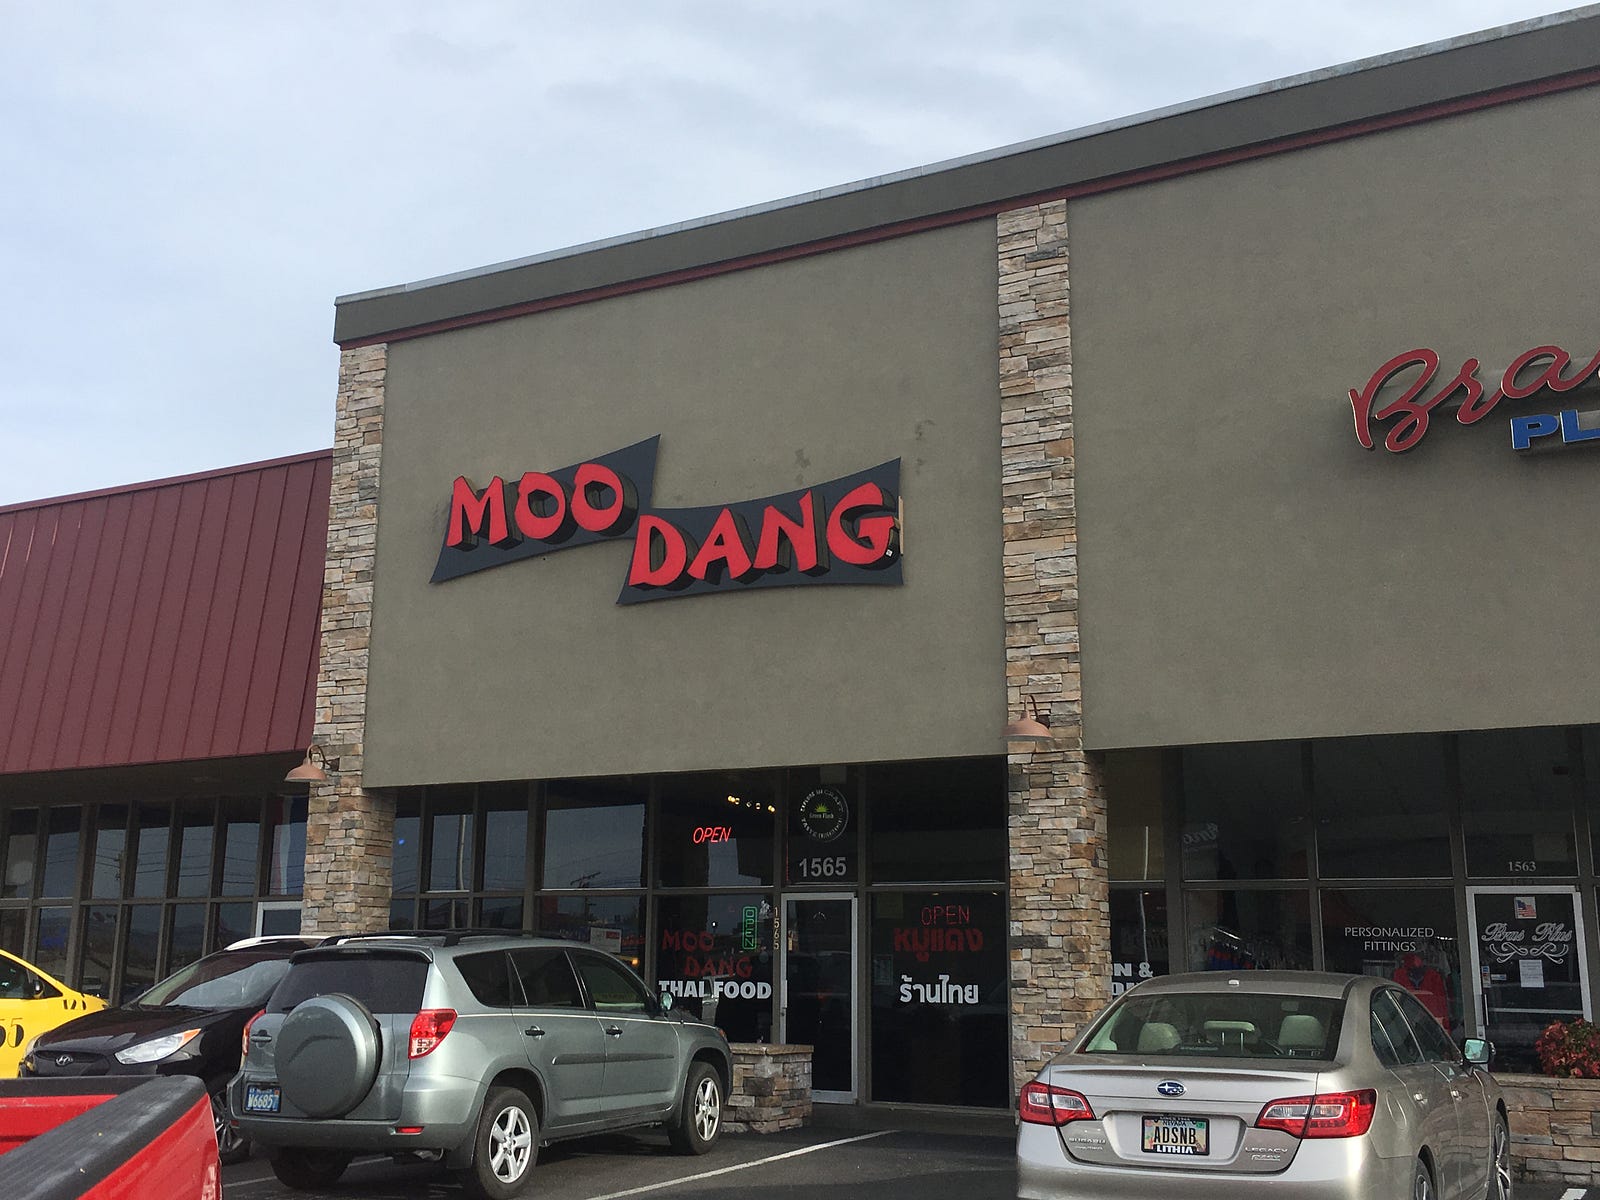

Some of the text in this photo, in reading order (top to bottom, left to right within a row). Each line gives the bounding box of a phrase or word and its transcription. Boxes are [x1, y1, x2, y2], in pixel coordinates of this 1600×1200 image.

[1348, 345, 1600, 452] Bra
[446, 464, 630, 549] MOO
[628, 481, 899, 588] DANG
[692, 826, 732, 844] OPEN
[799, 856, 847, 877] 1565
[1508, 861, 1537, 872] 1563
[921, 904, 970, 926] OPEN
[745, 909, 755, 947] OPEN
[1344, 927, 1435, 938] PERSONALIZED
[1481, 922, 1573, 942] Bras Plus
[662, 929, 715, 952] MOO
[1364, 941, 1417, 951] FITTINGS
[684, 956, 752, 978] DANG
[1138, 961, 1154, 978] &
[658, 980, 772, 999] THAI FOOD
[900, 974, 979, 1004] ร้านไทย
[1154, 1126, 1196, 1145] ADSNB
[1156, 1144, 1194, 1154] LITHIA
[1245, 1146, 1288, 1154] LEGACY
